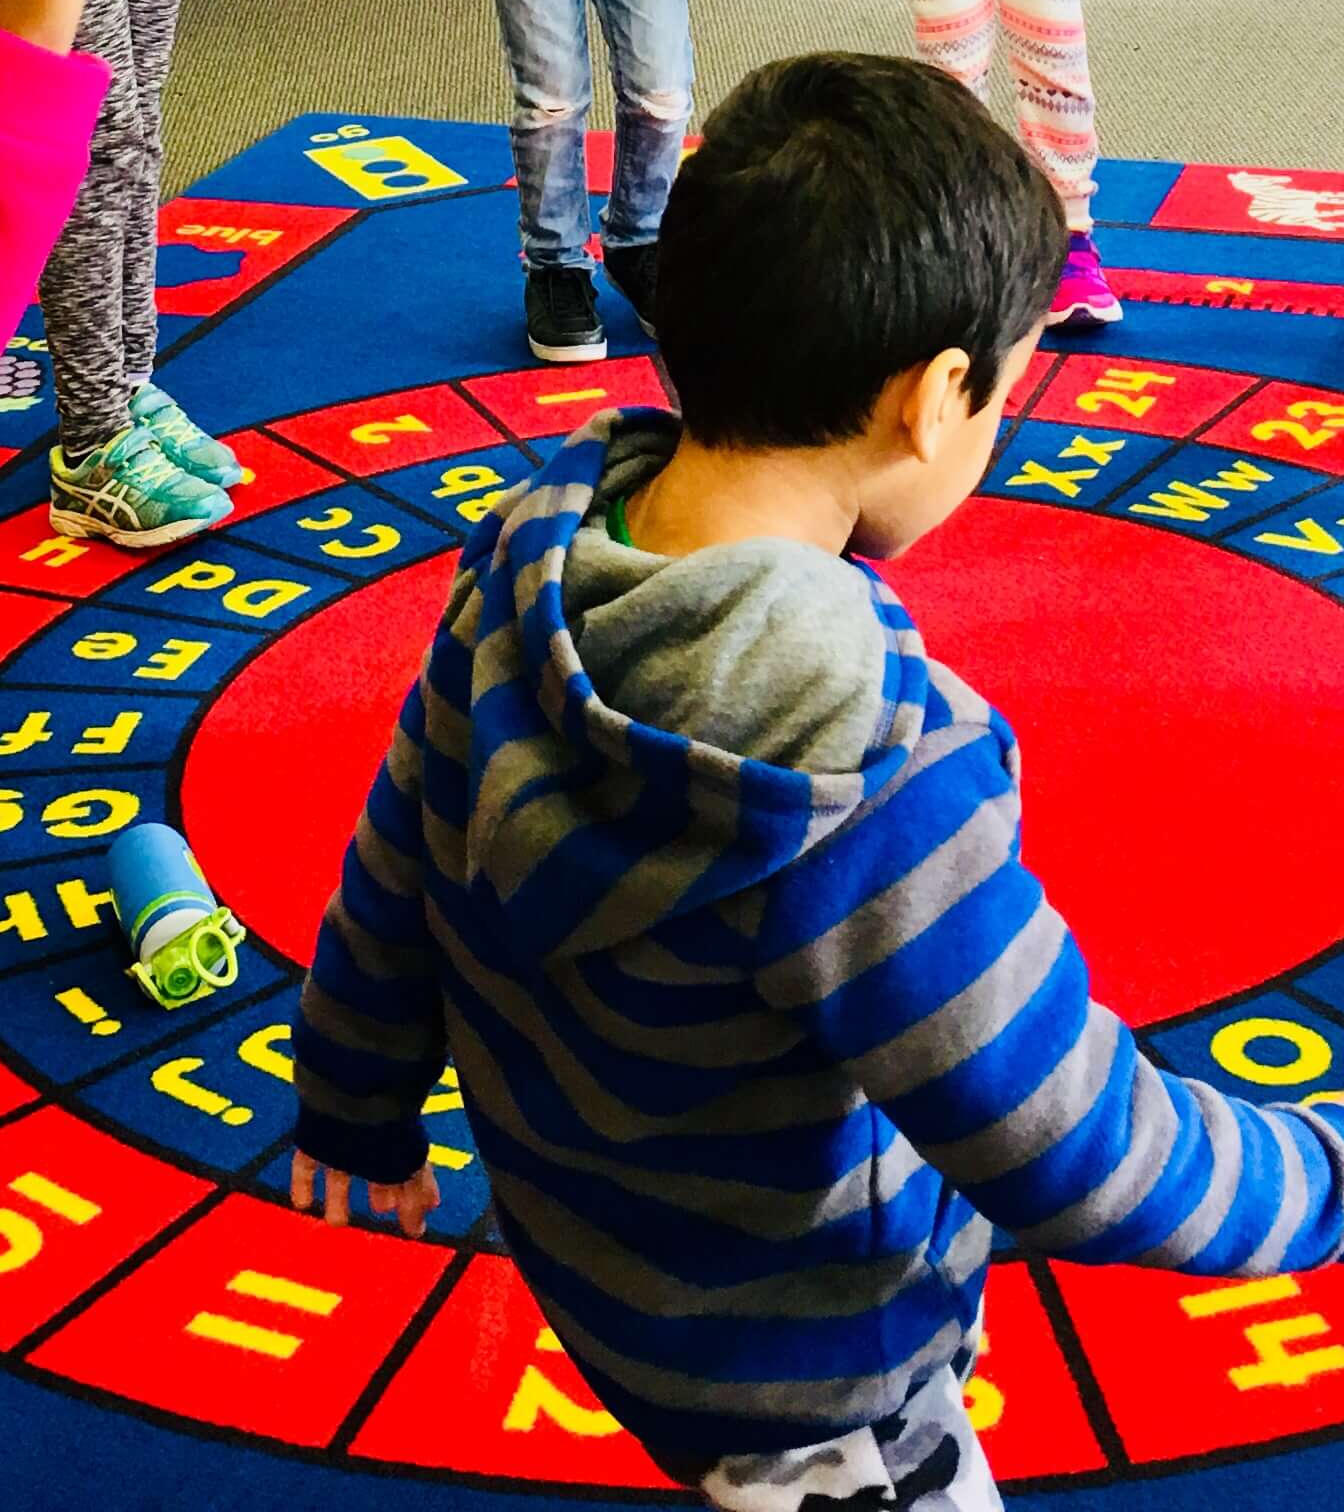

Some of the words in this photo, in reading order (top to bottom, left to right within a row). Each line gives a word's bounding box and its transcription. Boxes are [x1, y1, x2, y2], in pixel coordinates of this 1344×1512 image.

[310, 124, 370, 143] go
[175, 224, 284, 246] blue
[1075, 367, 1176, 419] 24
[351, 413, 432, 445] 2
[185, 1269, 343, 1360] 11
